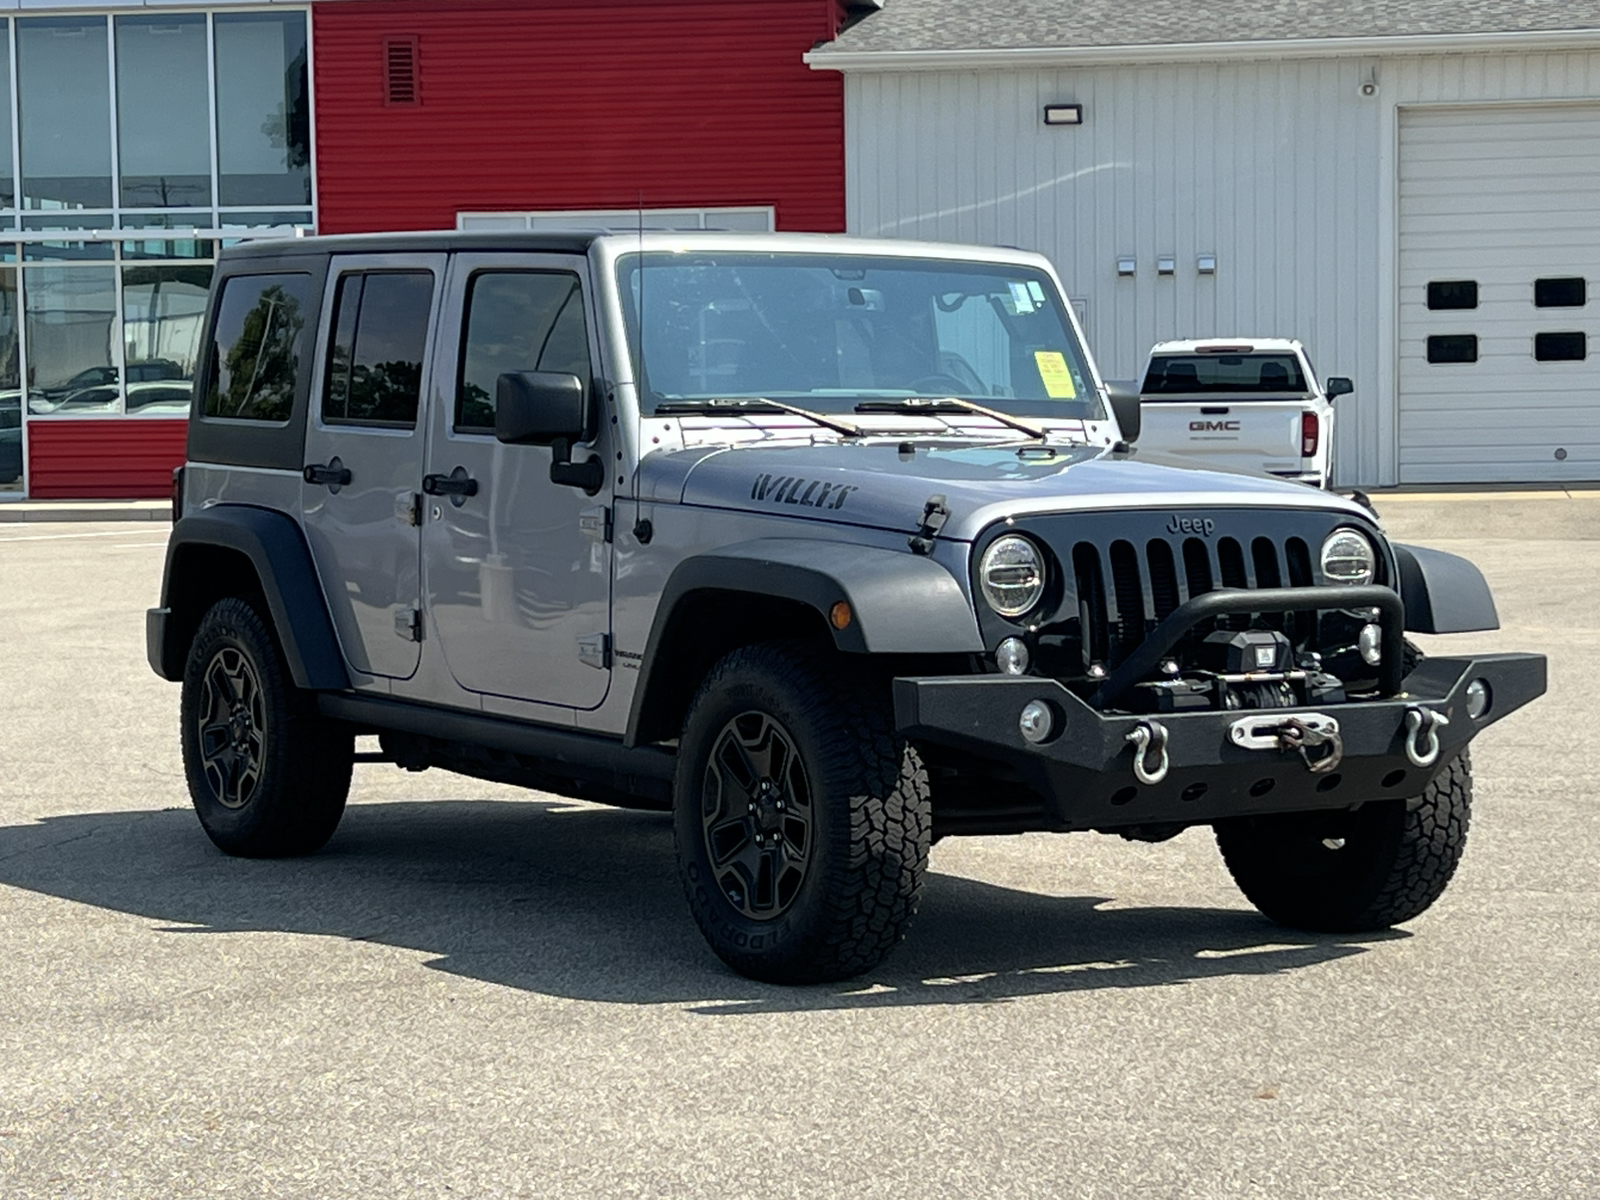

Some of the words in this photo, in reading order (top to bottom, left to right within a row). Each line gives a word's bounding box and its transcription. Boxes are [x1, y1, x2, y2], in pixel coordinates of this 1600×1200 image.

[1189, 421, 1241, 432] GMC
[751, 473, 859, 510] WILLYS
[1166, 514, 1215, 538] Jeep
